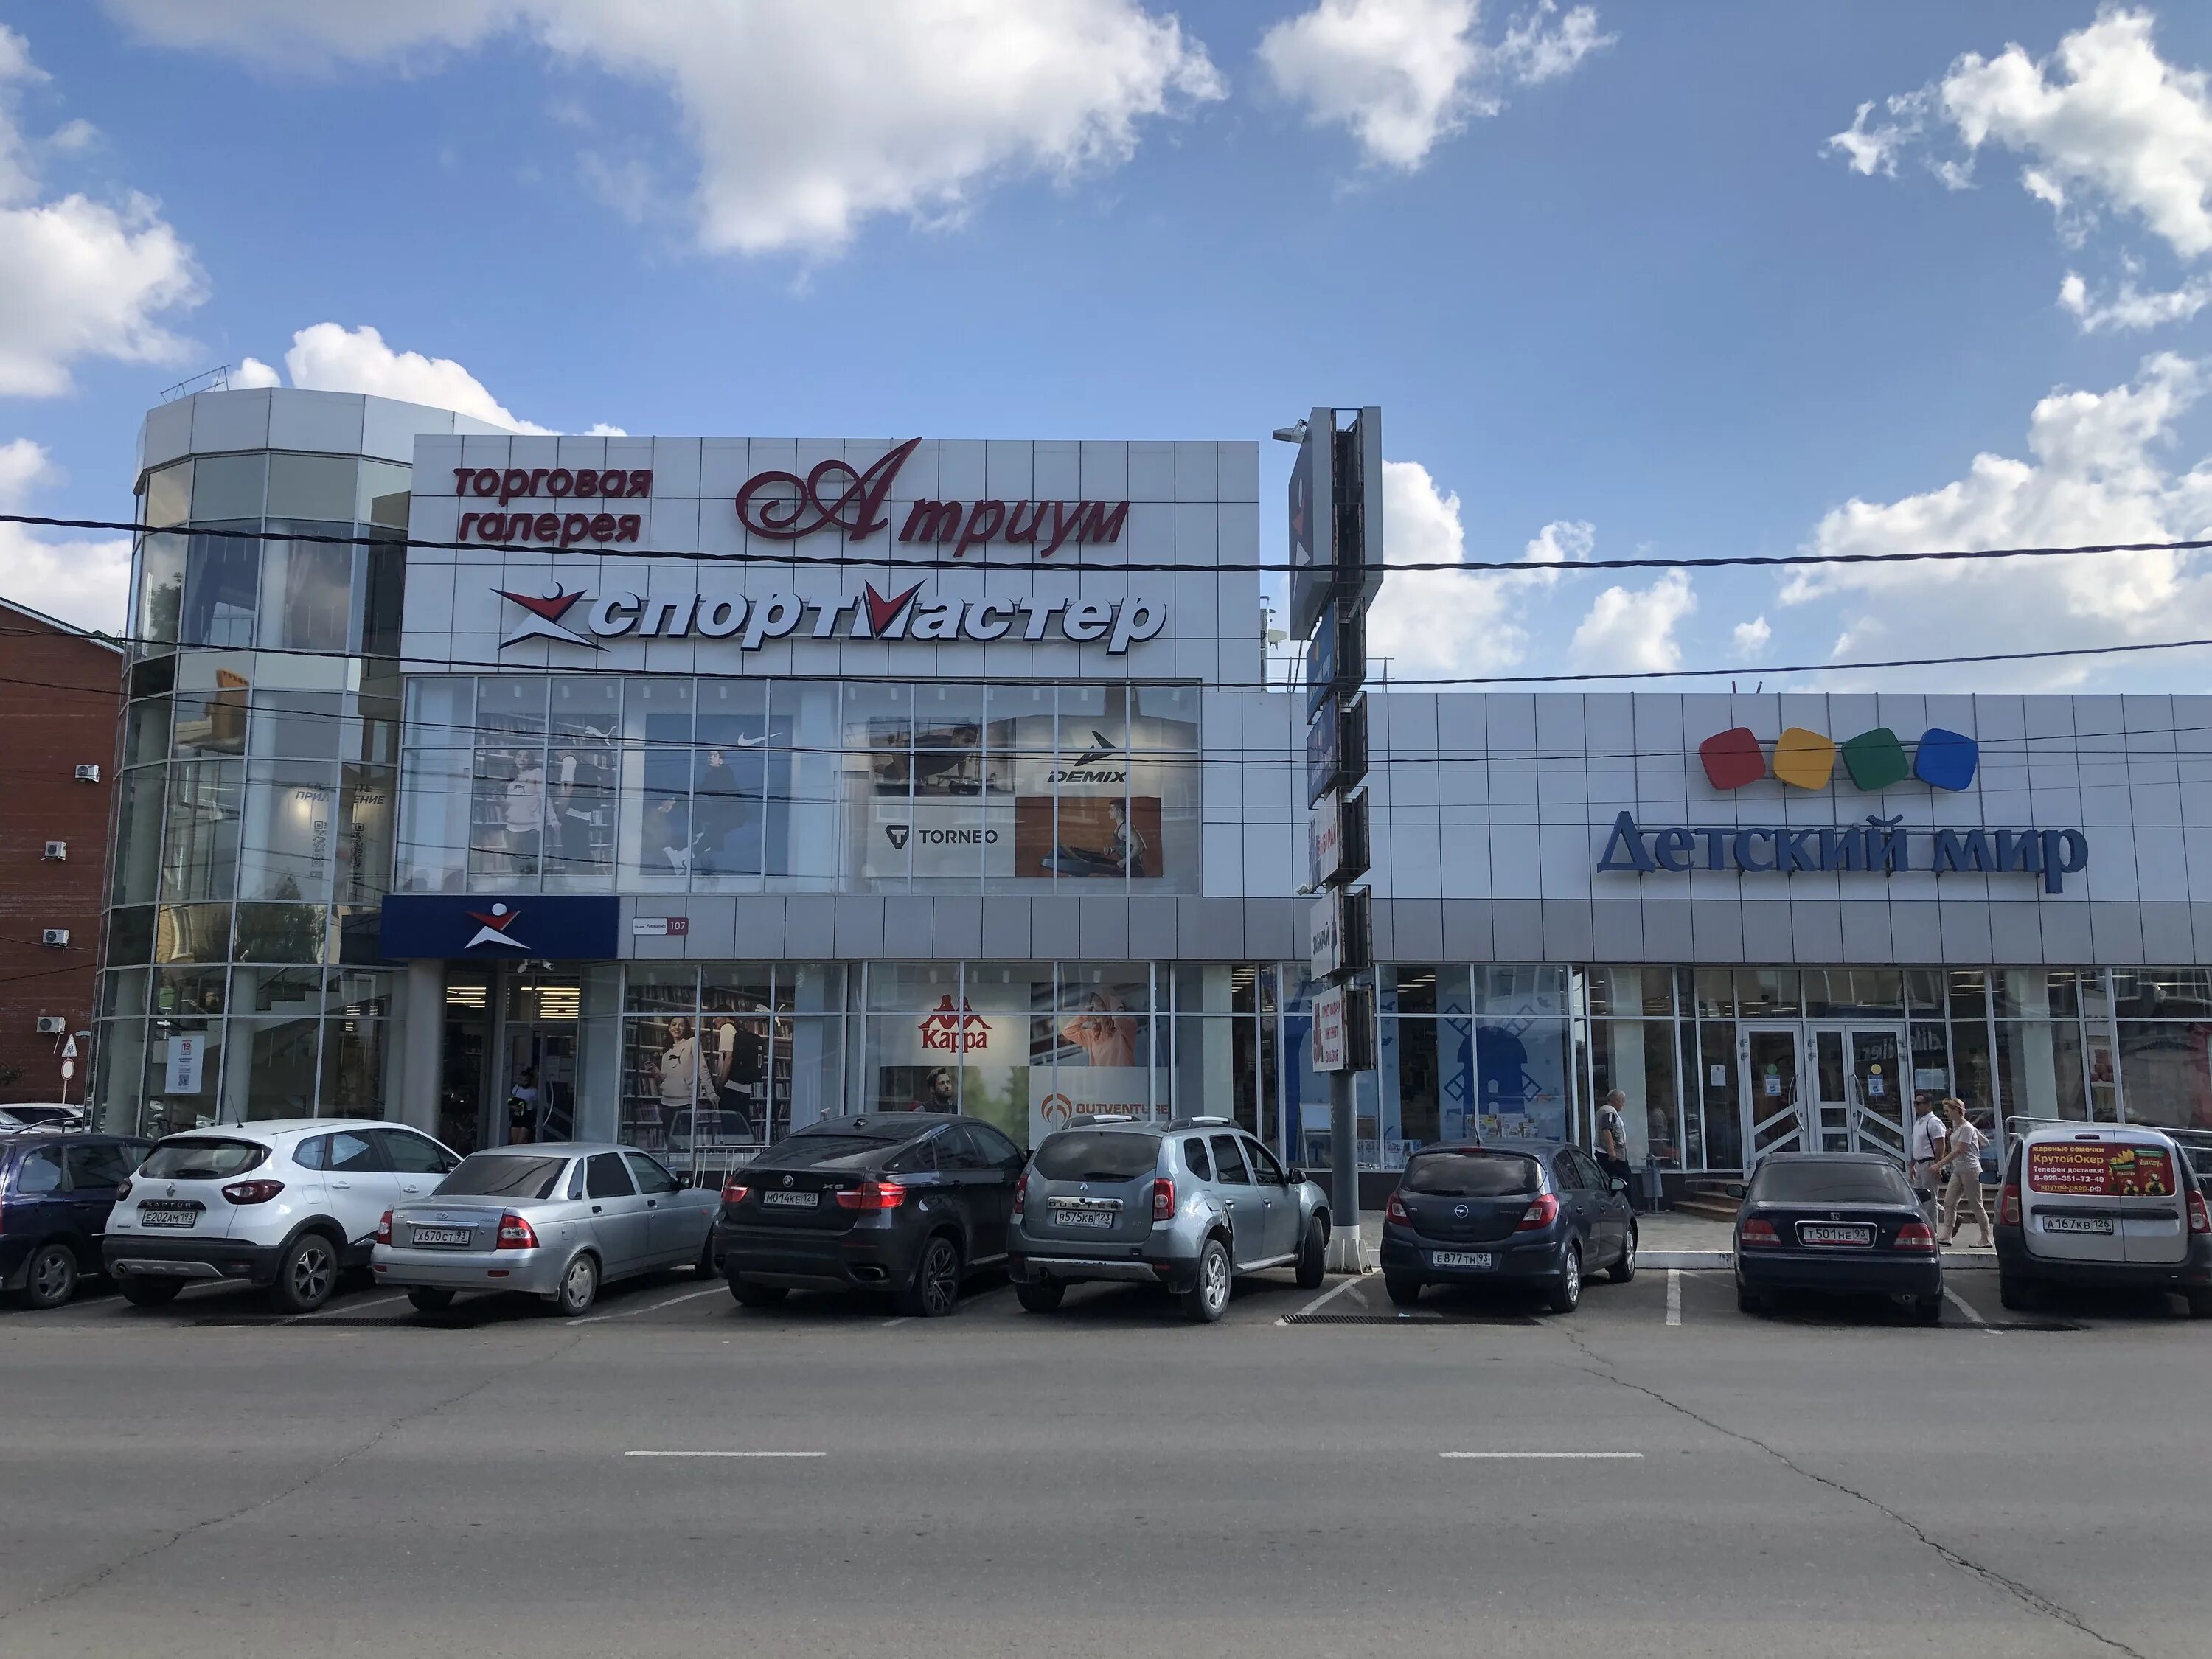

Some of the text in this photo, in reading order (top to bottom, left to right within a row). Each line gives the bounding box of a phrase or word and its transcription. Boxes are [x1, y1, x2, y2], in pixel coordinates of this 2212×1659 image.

[453, 468, 653, 507] торговая
[459, 512, 641, 548] галерея
[1047, 771, 1127, 783] DEMIX
[919, 830, 998, 844] TORNEO
[1597, 811, 2089, 894] Детский мир
[670, 922, 686, 930] 107
[922, 1029, 988, 1053] Kappa
